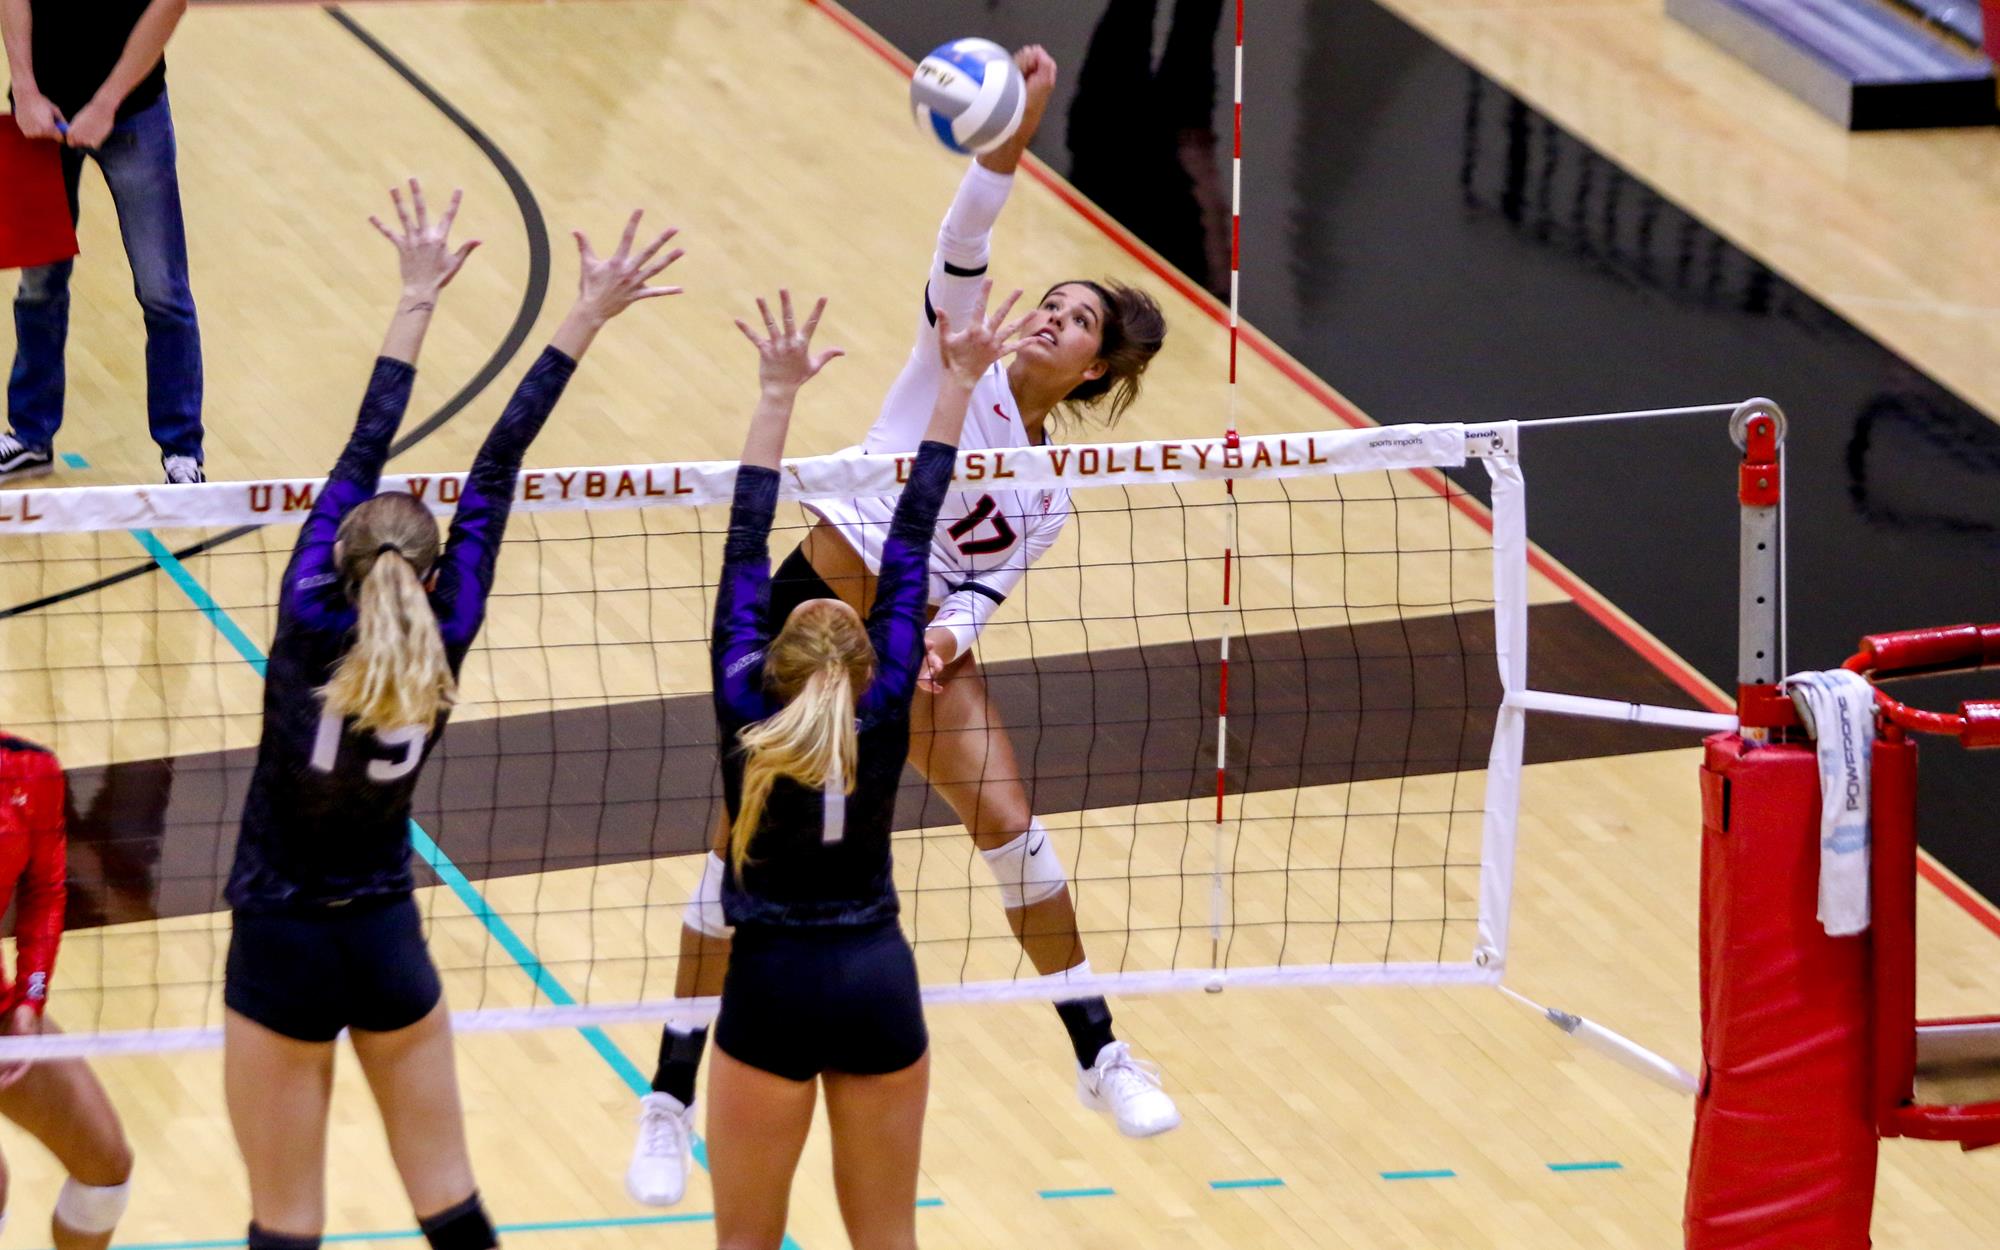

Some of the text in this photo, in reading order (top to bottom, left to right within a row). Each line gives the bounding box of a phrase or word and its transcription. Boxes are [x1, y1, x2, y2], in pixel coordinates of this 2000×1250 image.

[1369, 437, 1423, 448] sports imports
[1464, 429, 1497, 439] Senoh
[895, 438, 1327, 484] USL VOLLEYBALL
[249, 468, 693, 512] UM VOEYBALL
[947, 494, 1017, 556] 17
